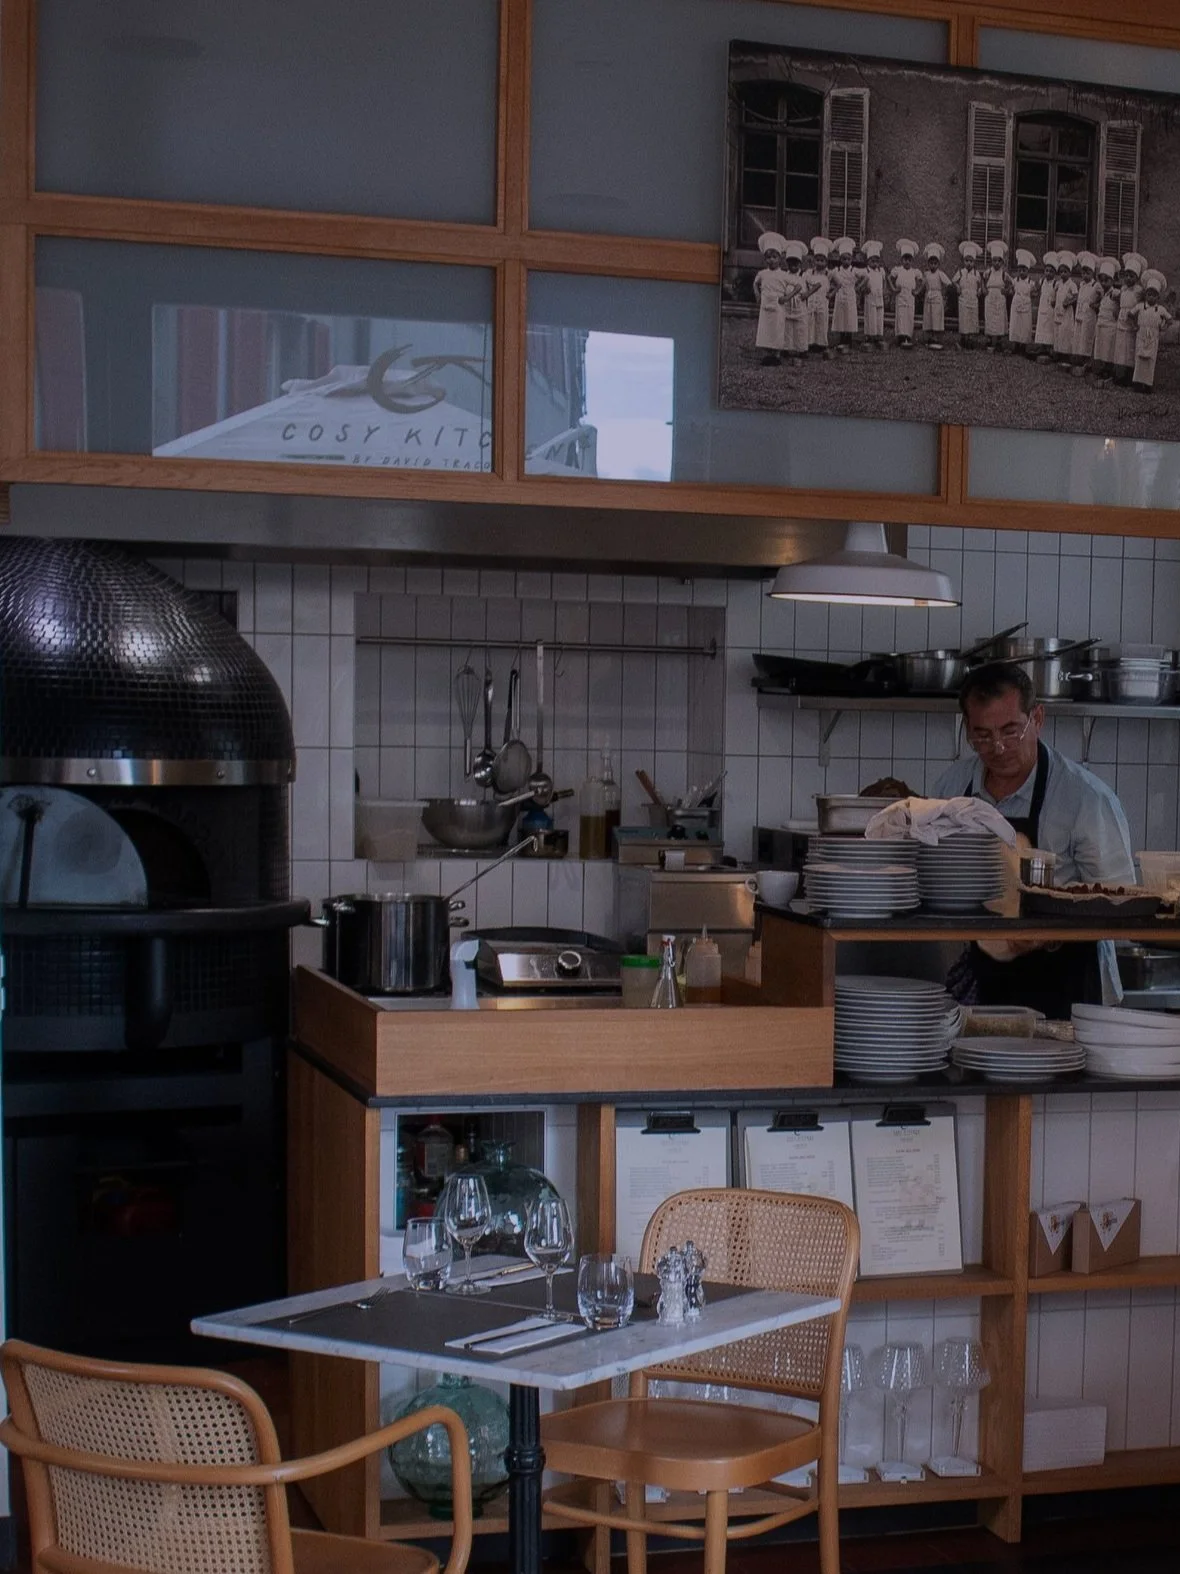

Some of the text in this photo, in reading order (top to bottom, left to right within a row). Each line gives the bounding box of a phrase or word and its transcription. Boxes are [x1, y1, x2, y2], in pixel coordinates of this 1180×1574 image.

[282, 423, 381, 444] COSY
[352, 454, 371, 465] BY
[381, 455, 432, 467] DAVID
